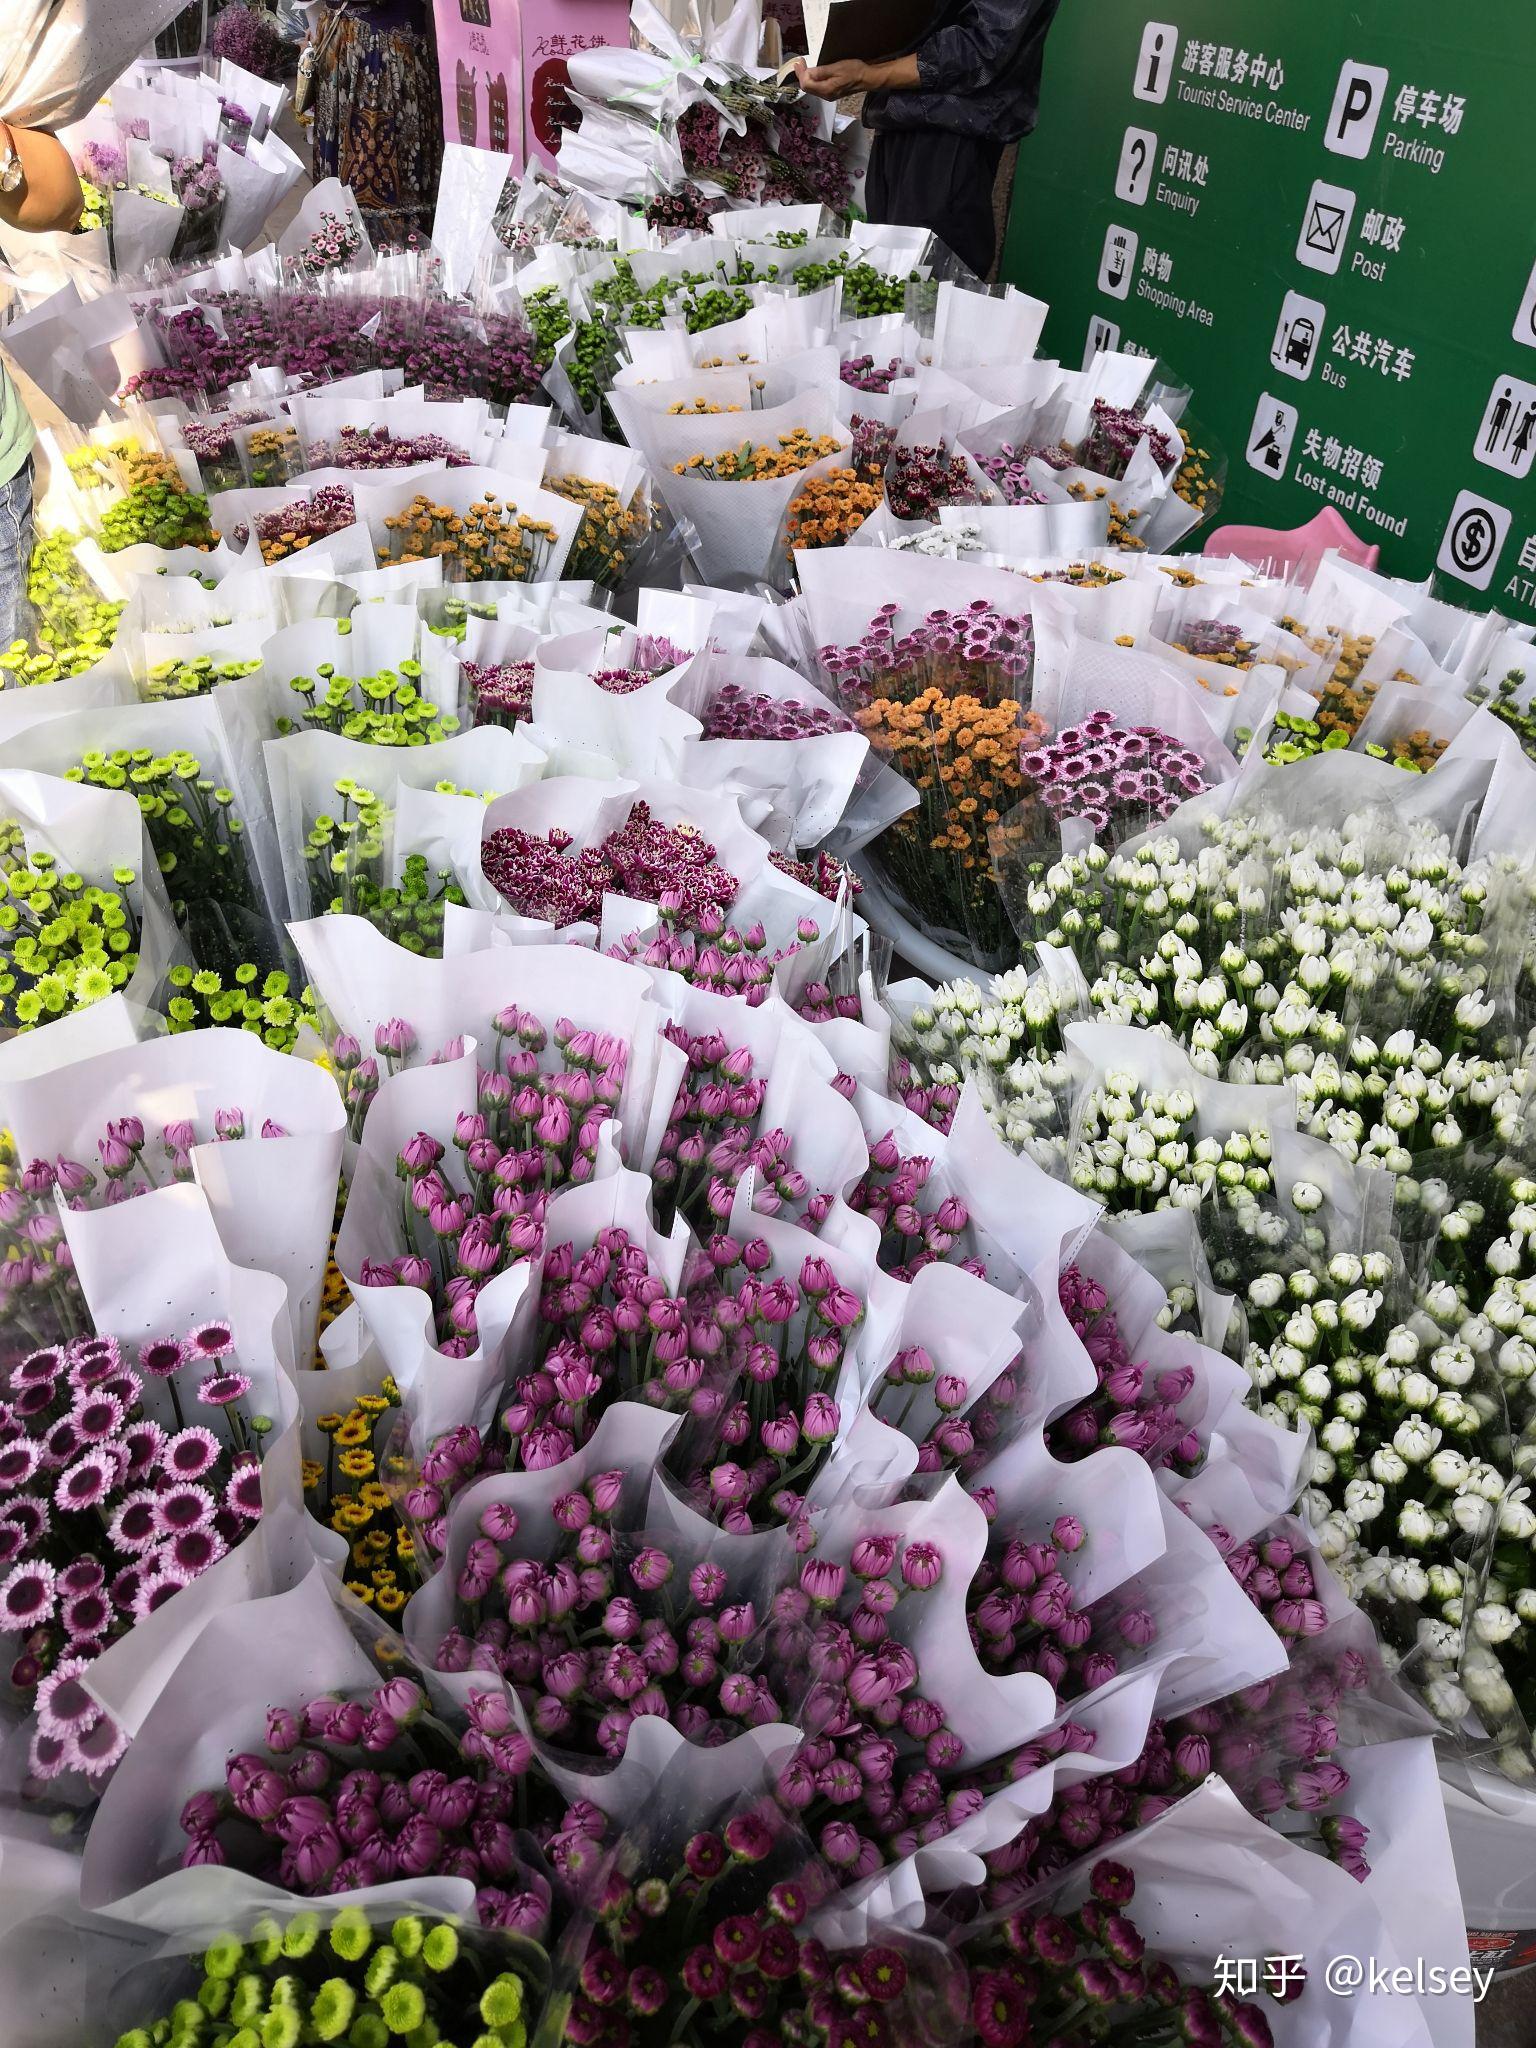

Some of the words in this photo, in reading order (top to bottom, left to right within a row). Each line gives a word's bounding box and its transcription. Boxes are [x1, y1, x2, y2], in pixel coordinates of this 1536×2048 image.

[550, 34, 608, 50] 鲜花饼
[1181, 40, 1284, 91] 游客服务中心
[1177, 80, 1217, 107] Tourist
[1217, 89, 1263, 119] Service
[1264, 101, 1311, 132] Center
[1393, 84, 1467, 135] 停车场
[1162, 145, 1209, 187] 问讯处
[1383, 132, 1446, 174] Parking
[1156, 182, 1200, 217] Enquiry
[1360, 208, 1407, 253] 邮政
[1142, 247, 1173, 282] 购物
[1351, 252, 1387, 282] Post
[1136, 279, 1186, 318] Shopping
[1186, 300, 1214, 327] Area
[1322, 363, 1347, 389] Bus
[1332, 325, 1416, 382] 公共汽车
[1302, 428, 1384, 491] 失物招领
[1295, 463, 1327, 494] Lost
[1326, 485, 1357, 510] and
[1357, 495, 1408, 538] Found
